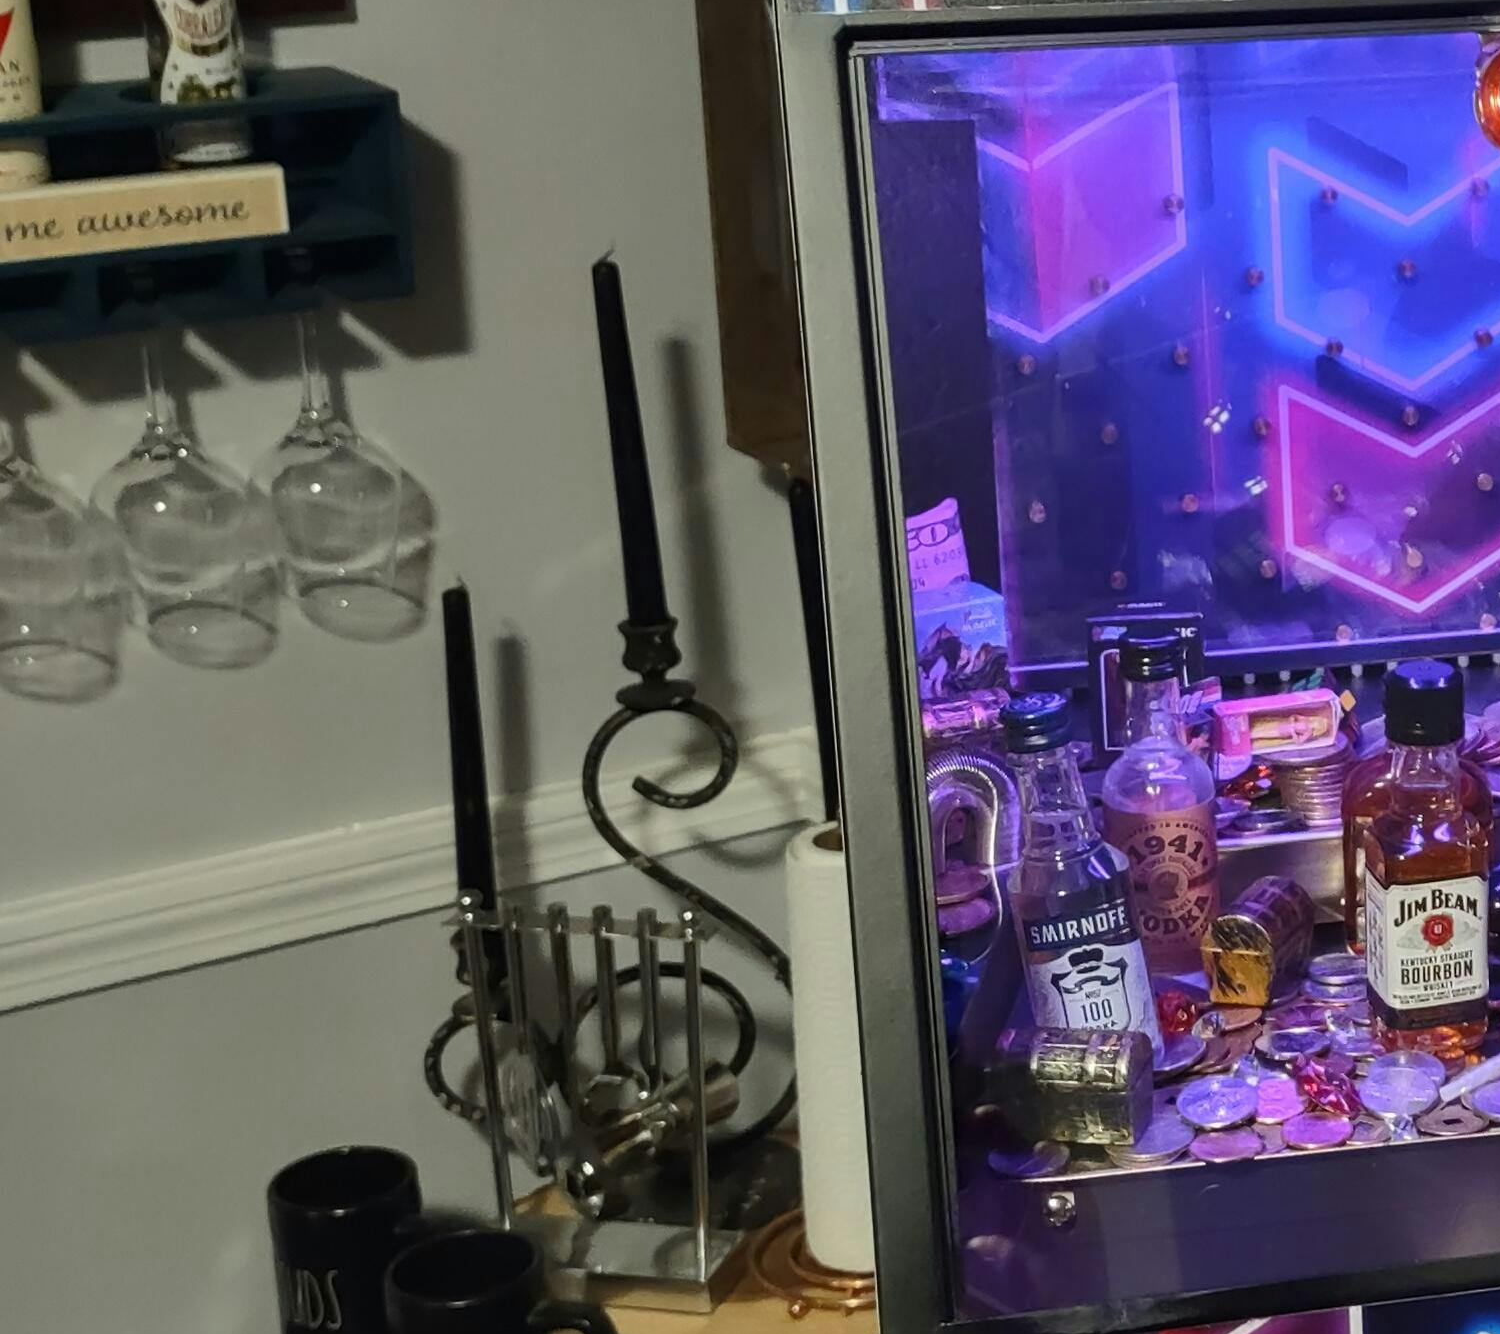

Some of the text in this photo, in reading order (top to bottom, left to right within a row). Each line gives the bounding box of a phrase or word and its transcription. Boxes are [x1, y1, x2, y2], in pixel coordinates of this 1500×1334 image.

[4, 199, 249, 242] me awesome
[1127, 834, 1204, 865] 1941
[1393, 888, 1479, 927] JIM BEAM
[1030, 905, 1127, 945] SMIRNOFF
[1400, 949, 1473, 967] KENTUCKY STRAIGHT
[1400, 959, 1474, 986] BOURBON
[1080, 998, 1113, 1023] 100
